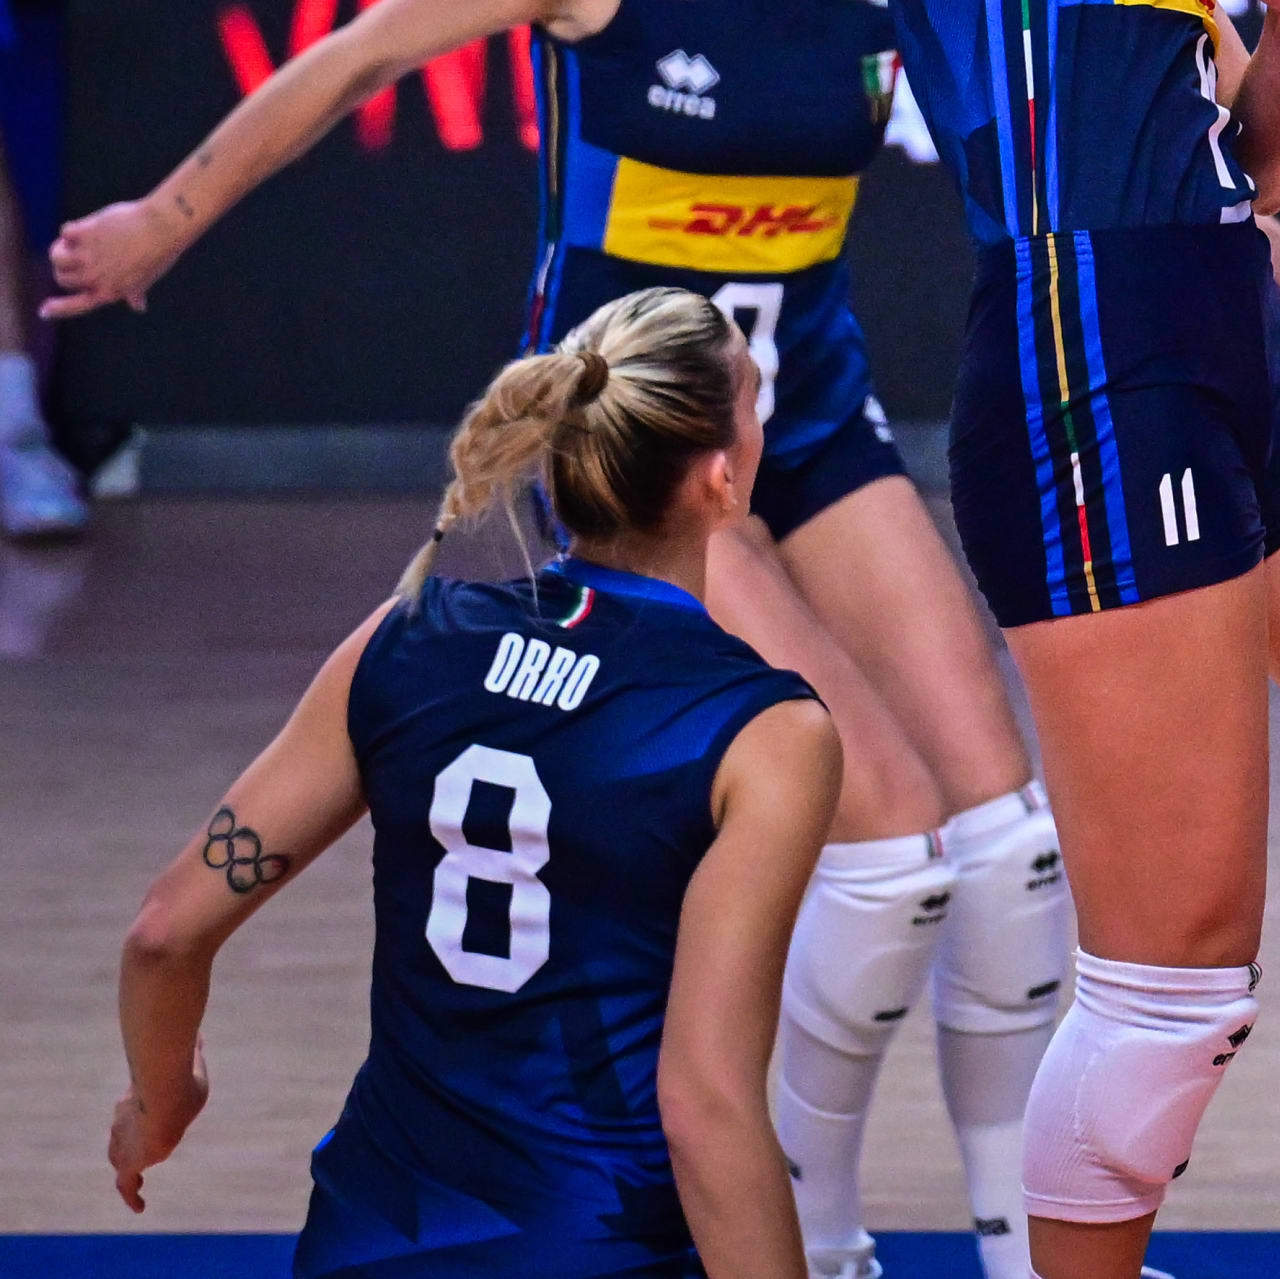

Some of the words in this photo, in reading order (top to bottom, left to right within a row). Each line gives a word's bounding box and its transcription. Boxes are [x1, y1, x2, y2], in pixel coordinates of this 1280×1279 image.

[684, 202, 832, 239] DHL
[1159, 467, 1200, 547] 11
[484, 632, 601, 712] ORRO
[425, 743, 553, 994] 8
